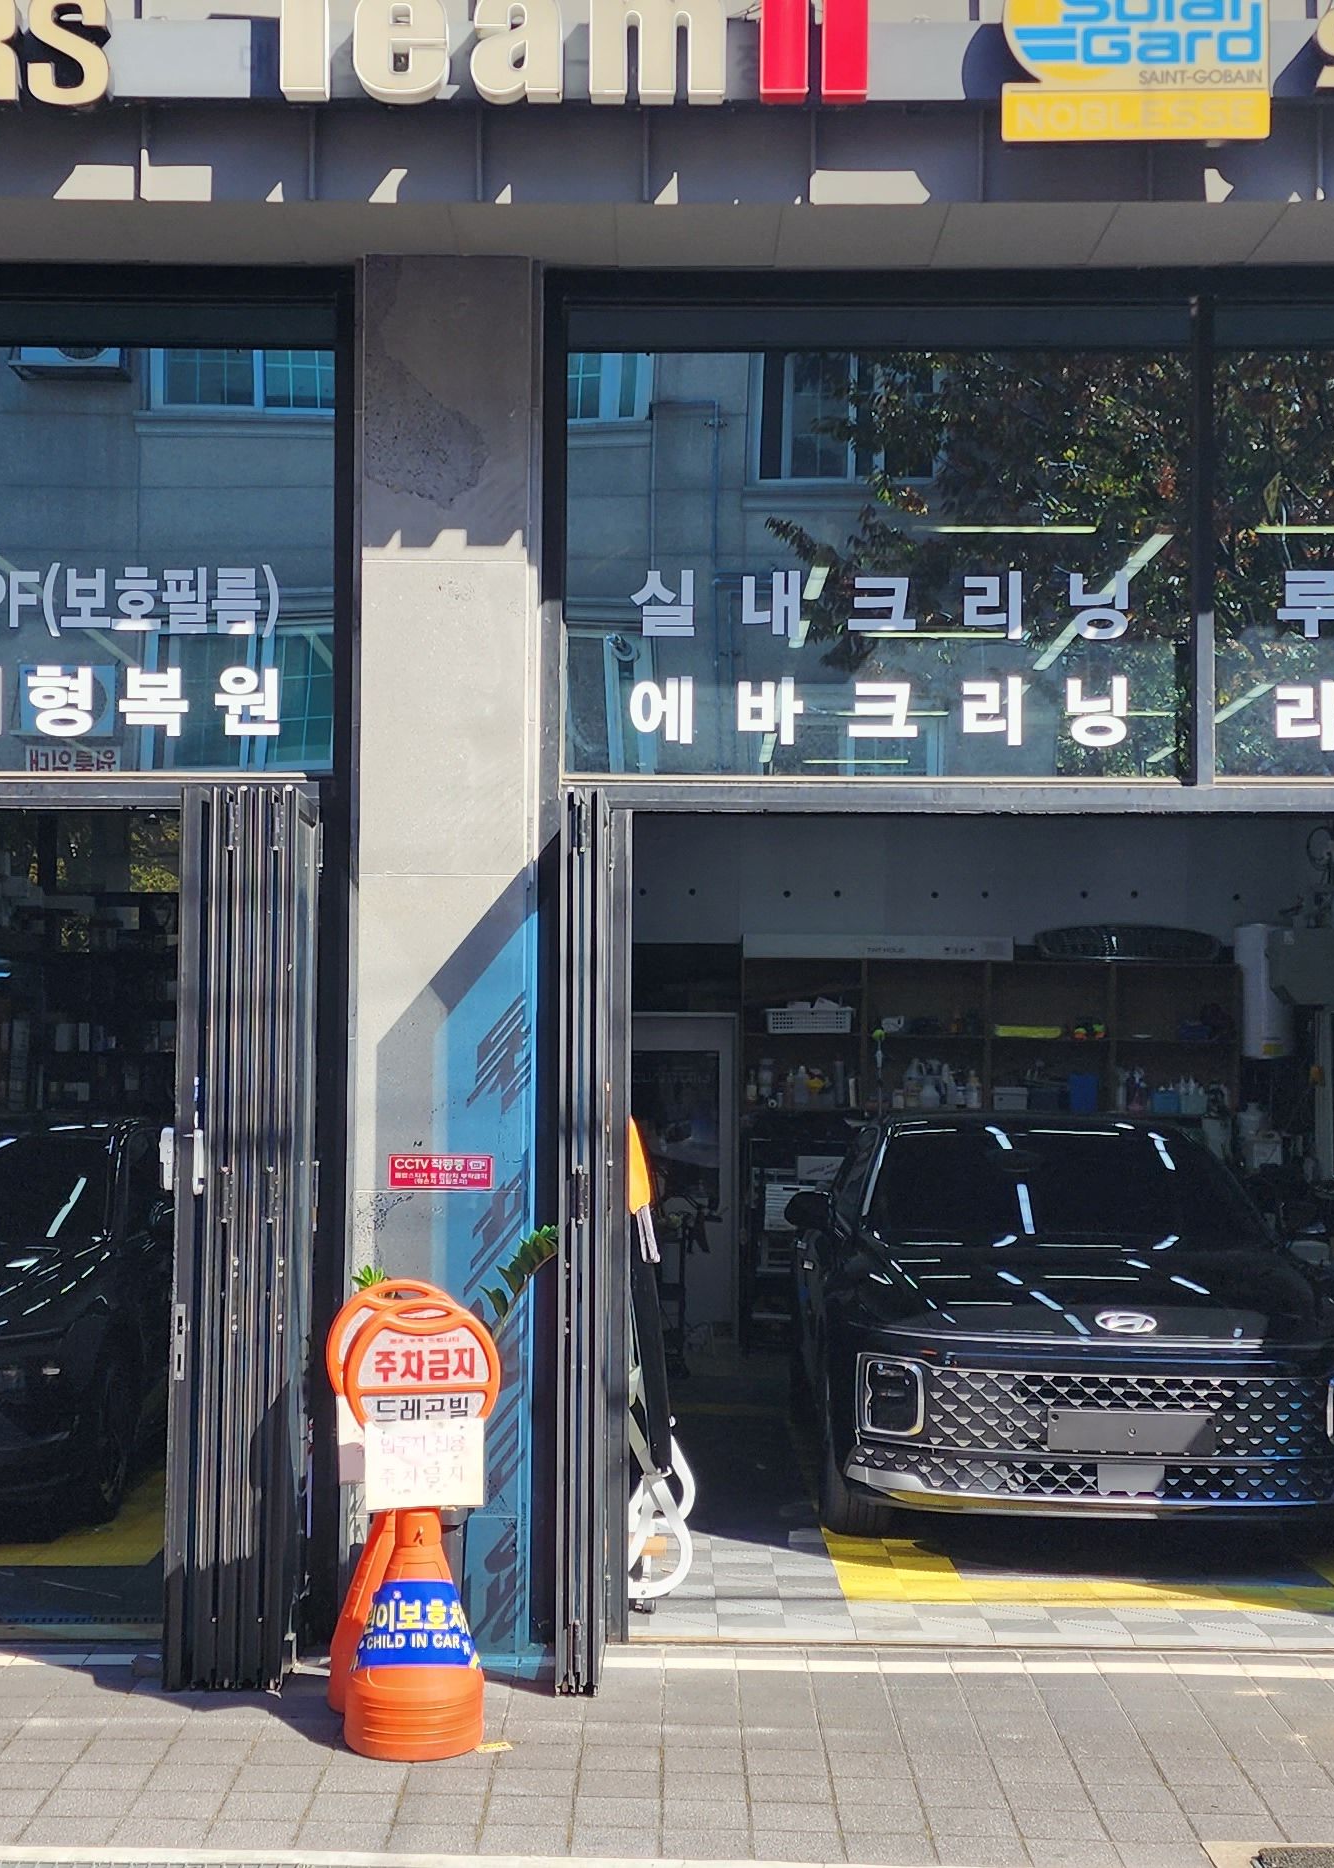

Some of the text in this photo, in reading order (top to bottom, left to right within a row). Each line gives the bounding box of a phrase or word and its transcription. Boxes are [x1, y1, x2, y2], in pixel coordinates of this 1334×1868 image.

[1081, 2, 1262, 64] Gard
[1138, 69, 1263, 85] SAINT-GOBAIN
[1015, 97, 1256, 132] NOBLESSE
[394, 1158, 429, 1170] CCTV
[374, 1347, 476, 1383] 주차금지
[367, 1633, 461, 1650] CHILD IN CAR
